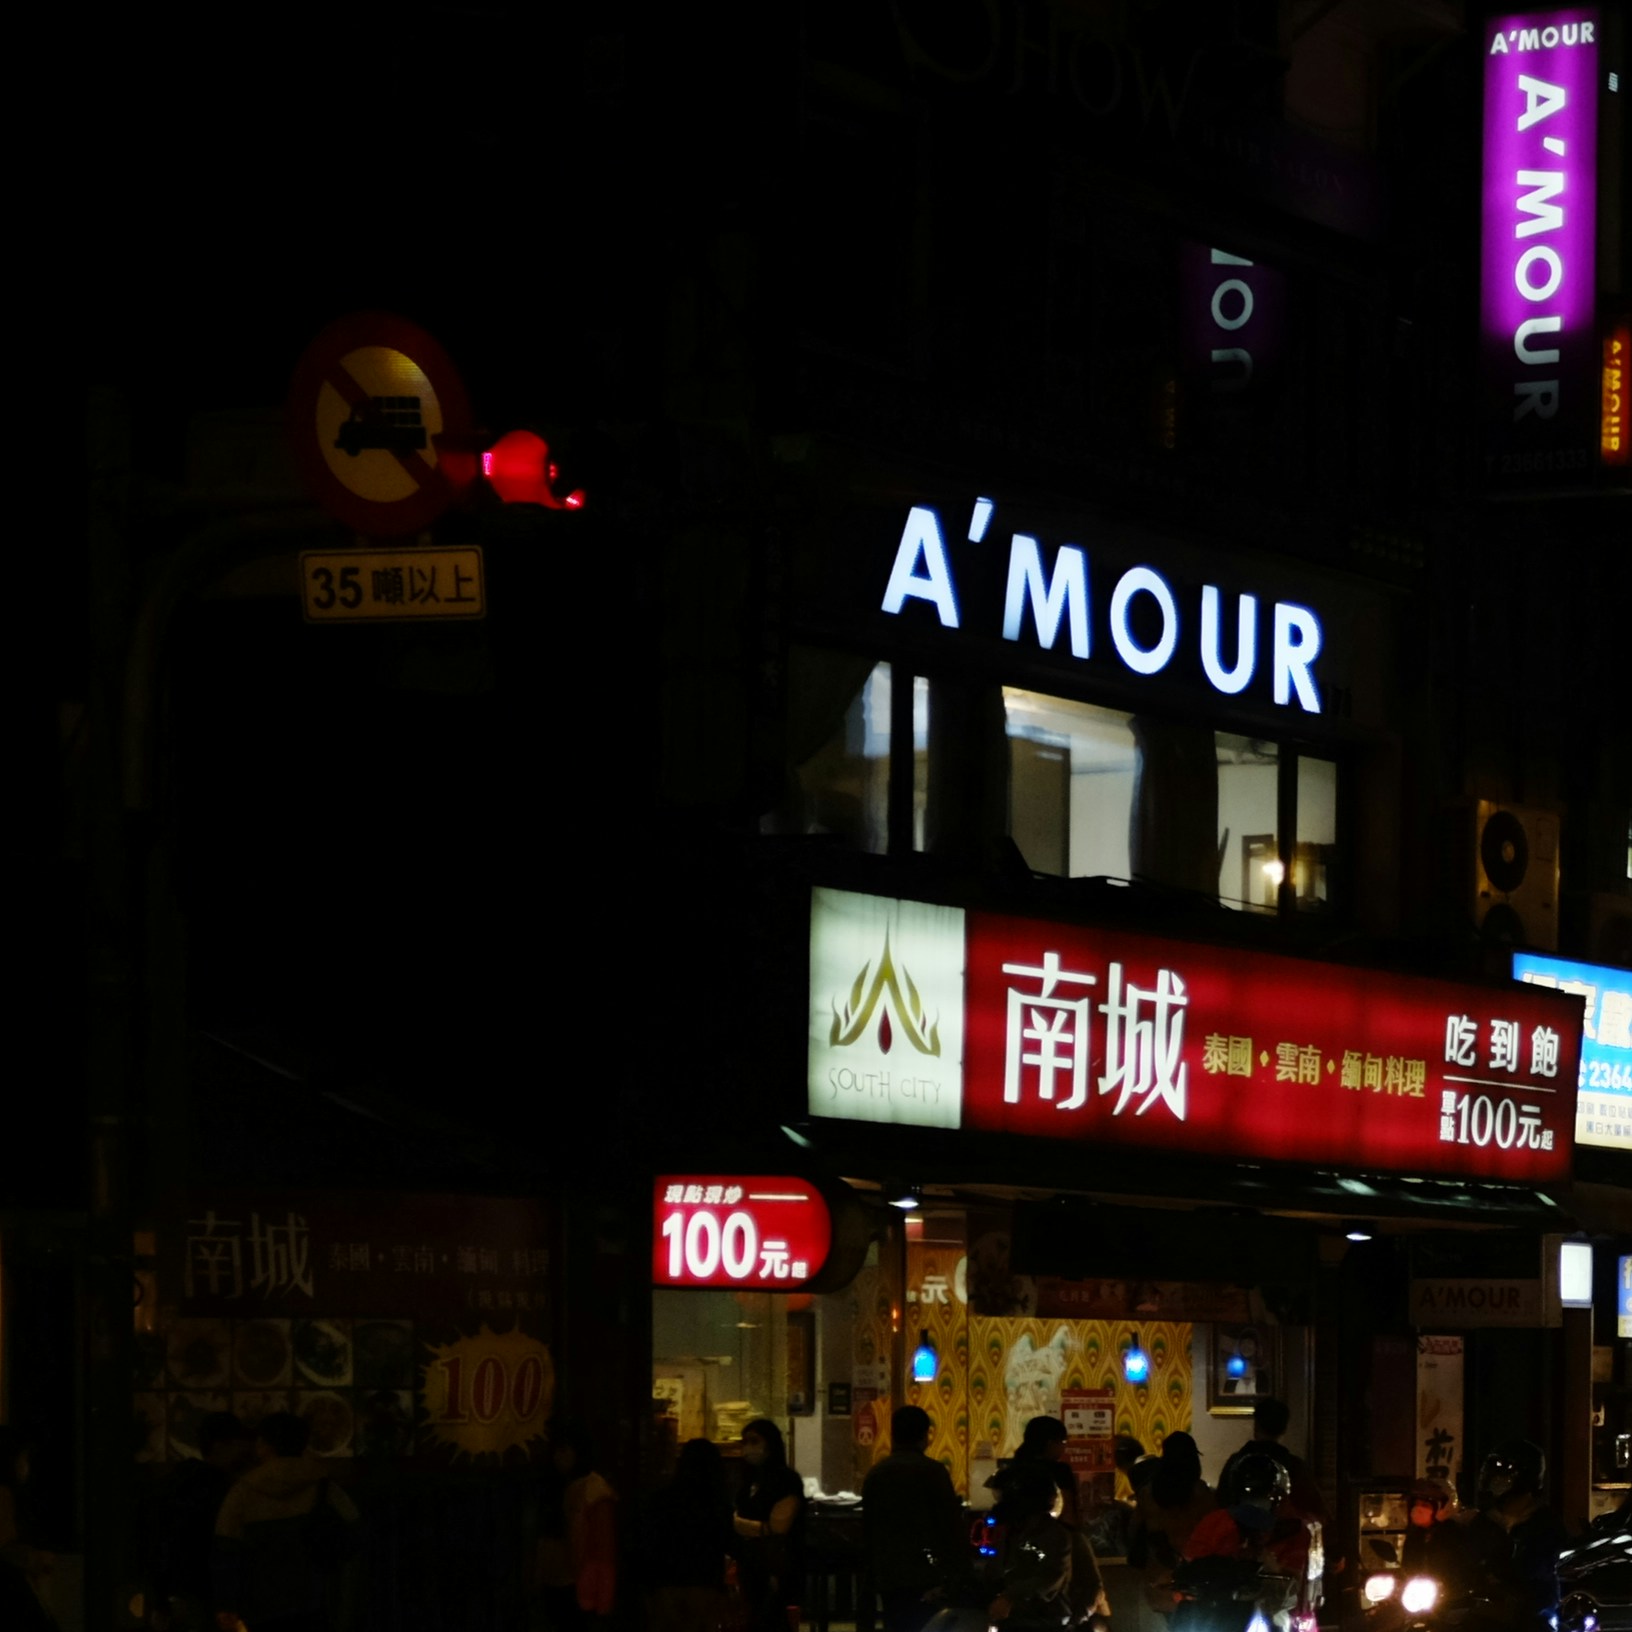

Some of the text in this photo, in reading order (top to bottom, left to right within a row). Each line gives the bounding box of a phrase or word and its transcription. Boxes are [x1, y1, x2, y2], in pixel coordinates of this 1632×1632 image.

[1489, 22, 1595, 56] A'MOUR
[1512, 73, 1567, 424] A'MOUR
[880, 495, 1324, 716] A'MOUR
[1002, 951, 1189, 1122] 南城
[1444, 1013, 1560, 1080] 吃到飽
[828, 1066, 942, 1106] SOUTH CITY
[183, 1209, 315, 1300] 南城
[1418, 1286, 1521, 1309] A'MOUR
[439, 1353, 546, 1425] 100
